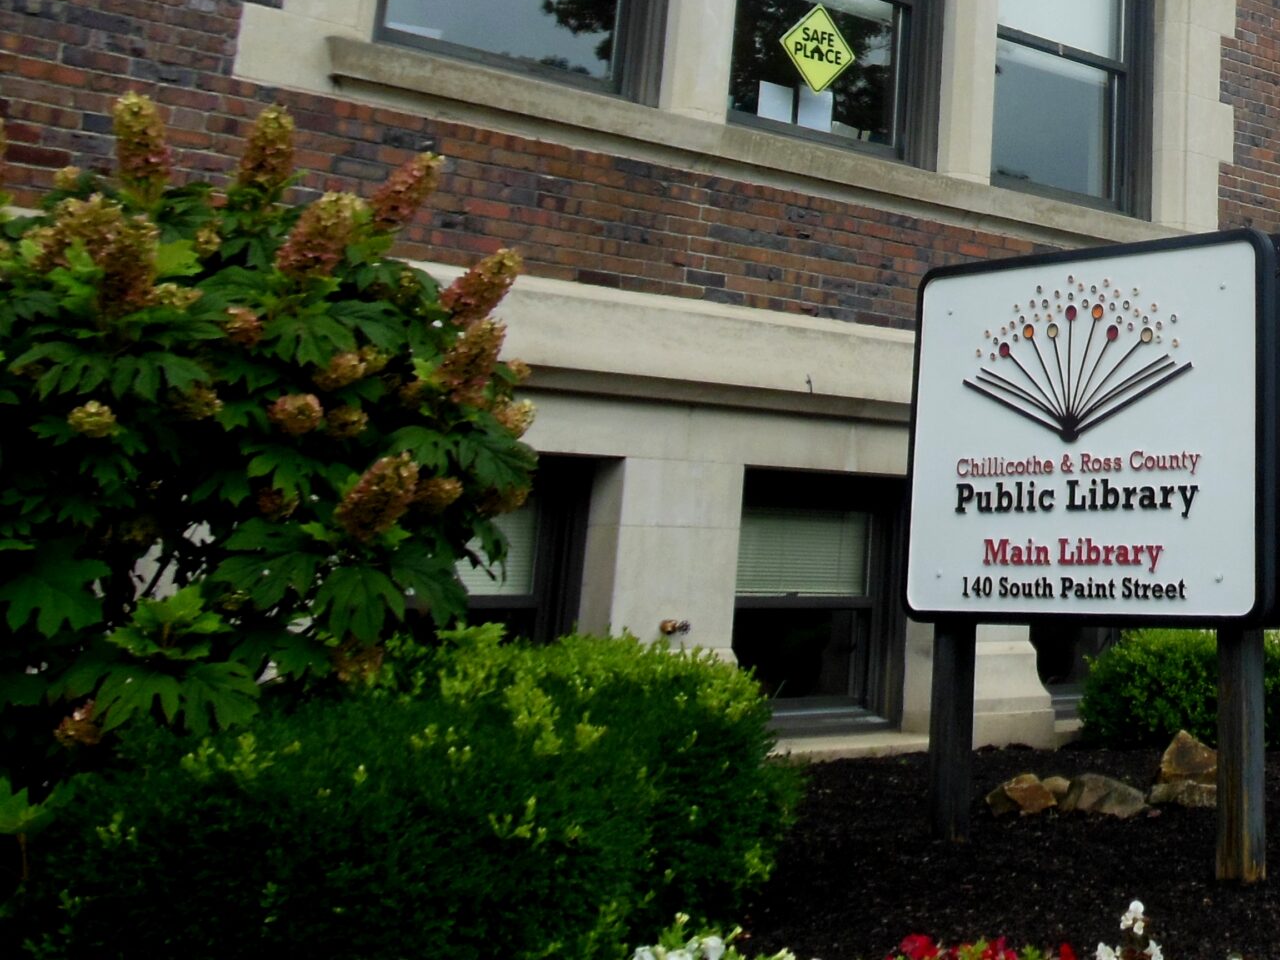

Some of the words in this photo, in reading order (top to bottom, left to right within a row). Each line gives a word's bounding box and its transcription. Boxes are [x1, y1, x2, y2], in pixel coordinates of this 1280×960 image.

[802, 27, 835, 48] SAFE
[956, 455, 1054, 477] Chillicothe
[1060, 454, 1073, 473] &
[1080, 453, 1122, 473] Ross
[1129, 450, 1201, 475] County
[954, 480, 1055, 515] Public
[1065, 478, 1200, 518] Library
[982, 538, 1051, 566] Main
[1057, 537, 1164, 573] Library
[962, 576, 993, 598] 140
[999, 576, 1054, 599] South
[1060, 577, 1116, 599] Paint
[1121, 577, 1187, 600] Street
